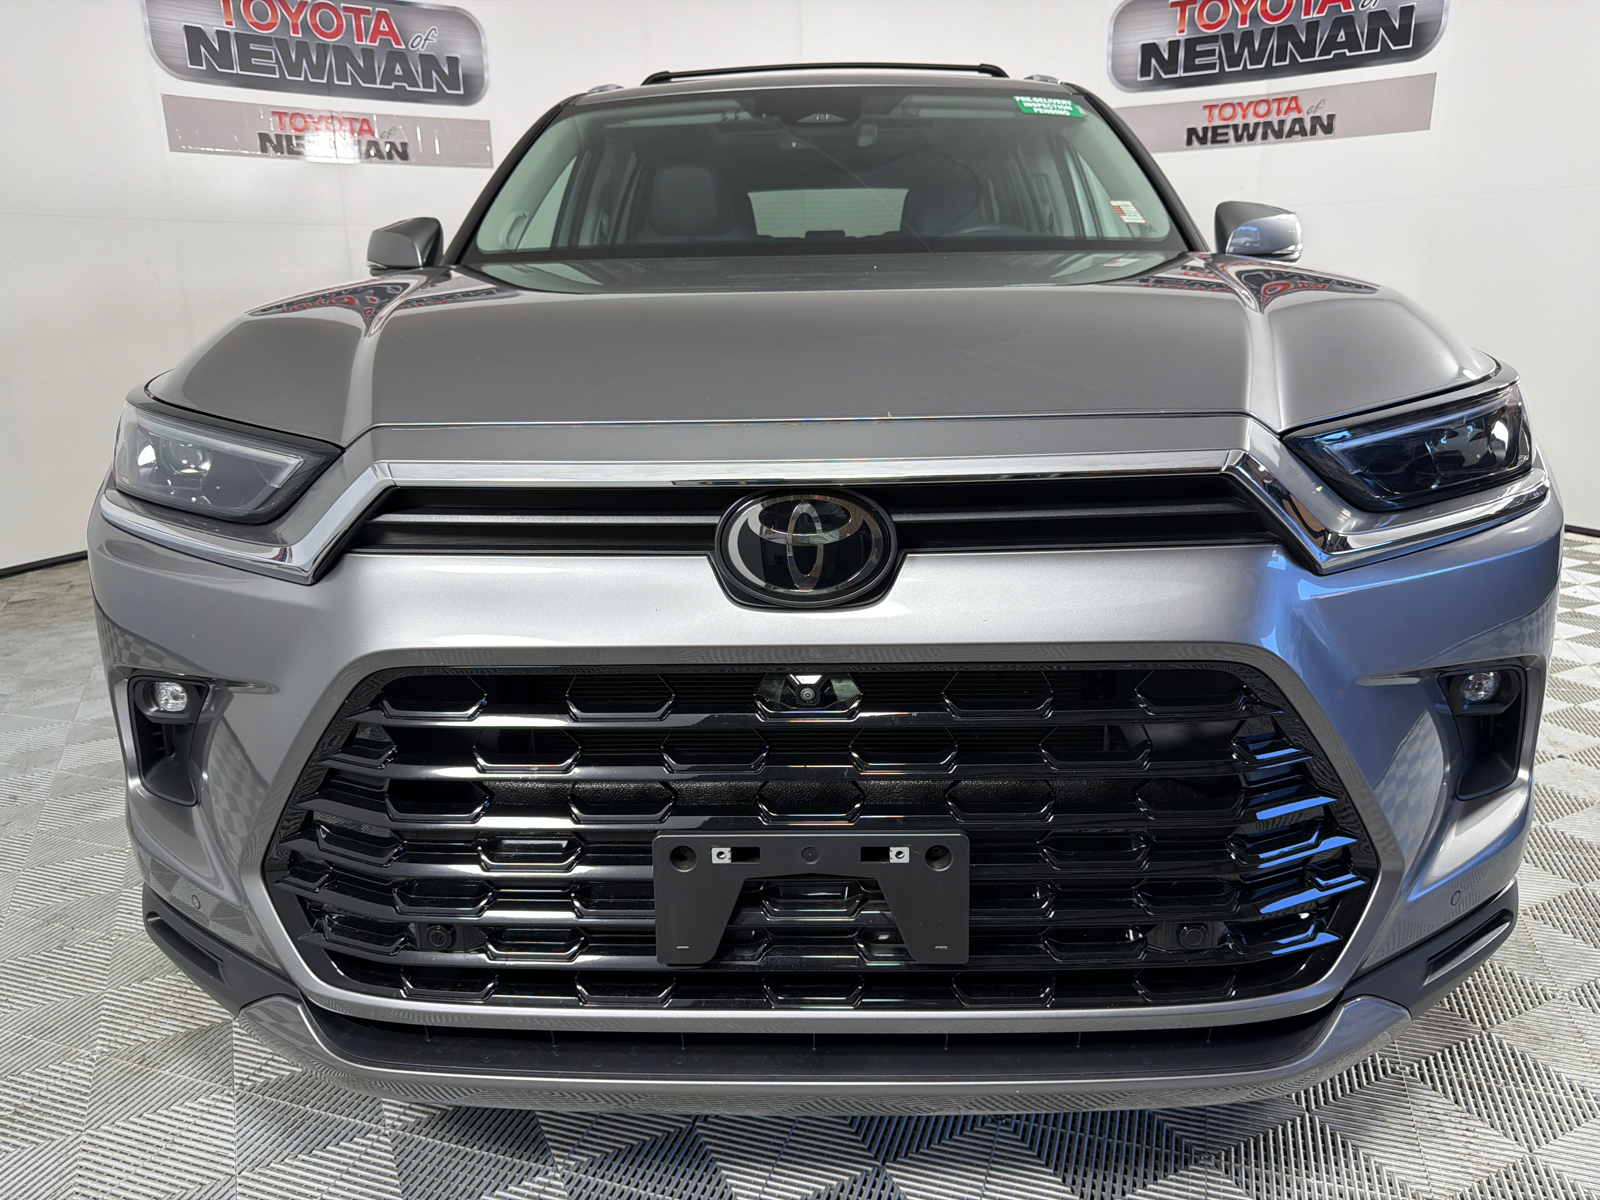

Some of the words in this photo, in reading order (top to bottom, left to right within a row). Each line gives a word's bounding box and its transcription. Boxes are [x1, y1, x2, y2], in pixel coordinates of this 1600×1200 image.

[221, 0, 405, 48] TOYOTA
[408, 26, 438, 50] of
[1137, 2, 1416, 81] NEWNAN
[182, 22, 464, 94] NEWNAN
[1023, 102, 1073, 111] INSPECTION
[1033, 108, 1070, 116] PENDING
[1203, 96, 1303, 123] TOYOTA
[1306, 98, 1326, 115] of
[271, 110, 375, 138] TOYOTA
[380, 126, 396, 139] of
[1186, 113, 1336, 147] NEWNAN
[258, 132, 409, 161] NEAN
